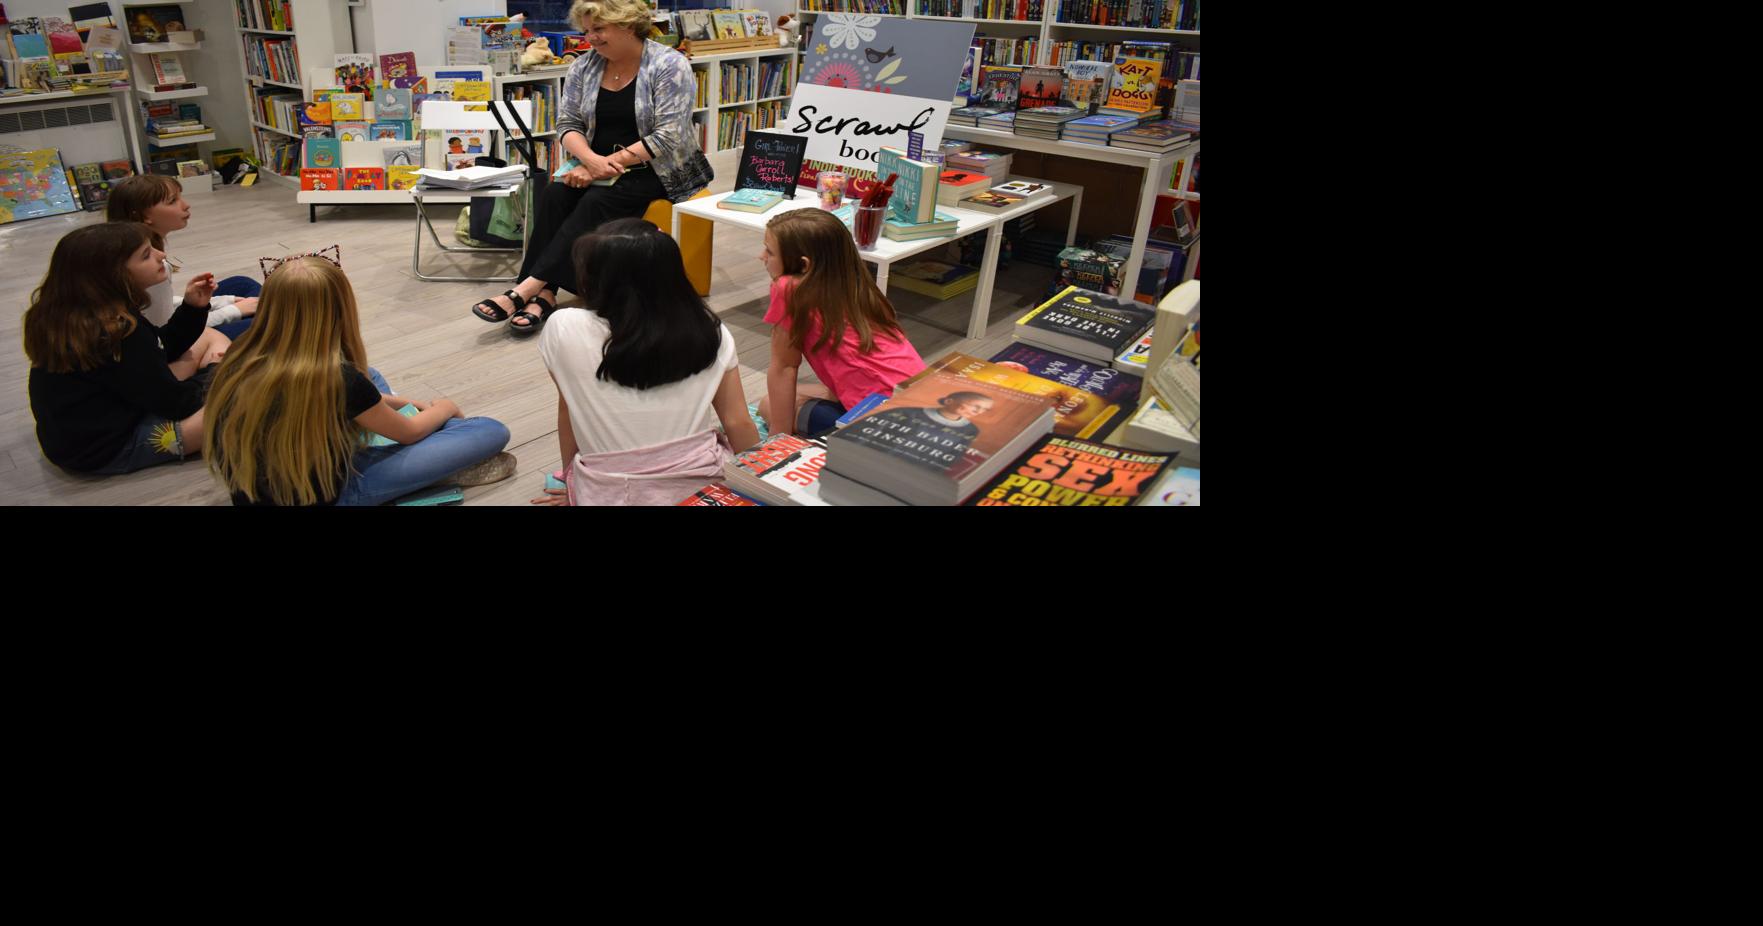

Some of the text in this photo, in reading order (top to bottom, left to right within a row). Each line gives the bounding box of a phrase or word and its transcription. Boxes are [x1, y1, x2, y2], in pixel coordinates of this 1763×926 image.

[1119, 63, 1153, 77] KATT
[792, 105, 935, 135] Scrawl
[750, 155, 785, 166] Barbara
[839, 139, 880, 164] boo
[862, 427, 956, 462] GINSBURG
[866, 416, 910, 434] RUTH
[916, 430, 979, 456] BADER
[1048, 437, 1168, 463] BLURRED LINES
[782, 452, 826, 487] ONG
[1040, 444, 1162, 473] RETHINKING
[998, 473, 1131, 506] POWER
[1017, 453, 1157, 497] SEX
